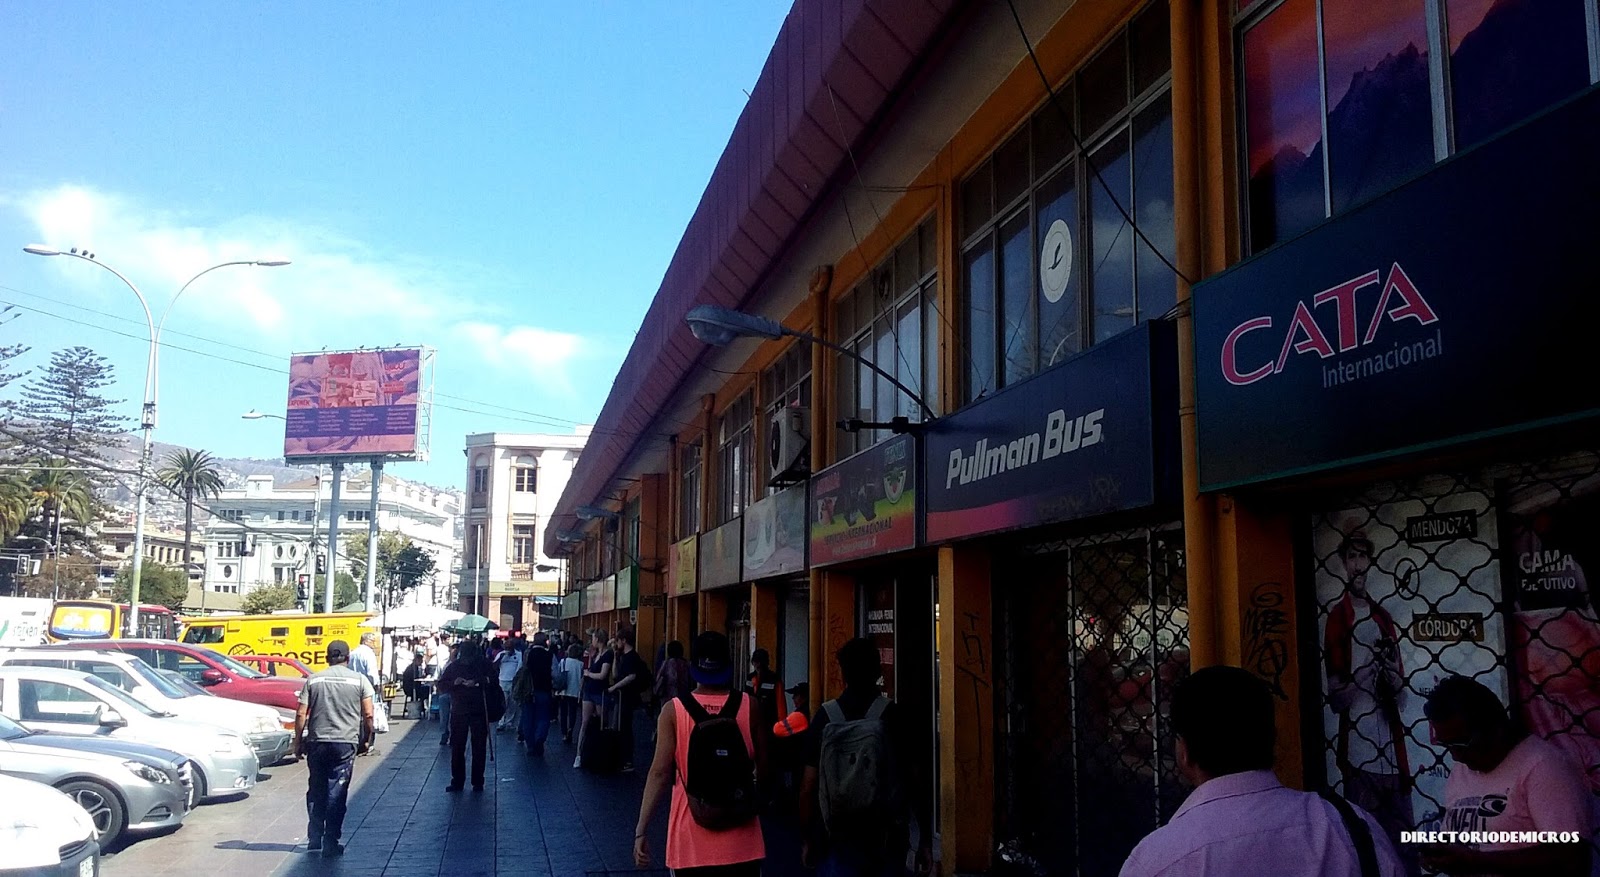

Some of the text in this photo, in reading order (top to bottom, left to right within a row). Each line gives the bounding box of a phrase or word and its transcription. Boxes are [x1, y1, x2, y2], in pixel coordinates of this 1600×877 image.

[1220, 261, 1440, 386] CATA
[1322, 329, 1443, 389] Internacional
[945, 408, 1105, 489] Pullman Bus
[1411, 516, 1473, 539] MENDOZA
[1519, 549, 1576, 574] CAMA
